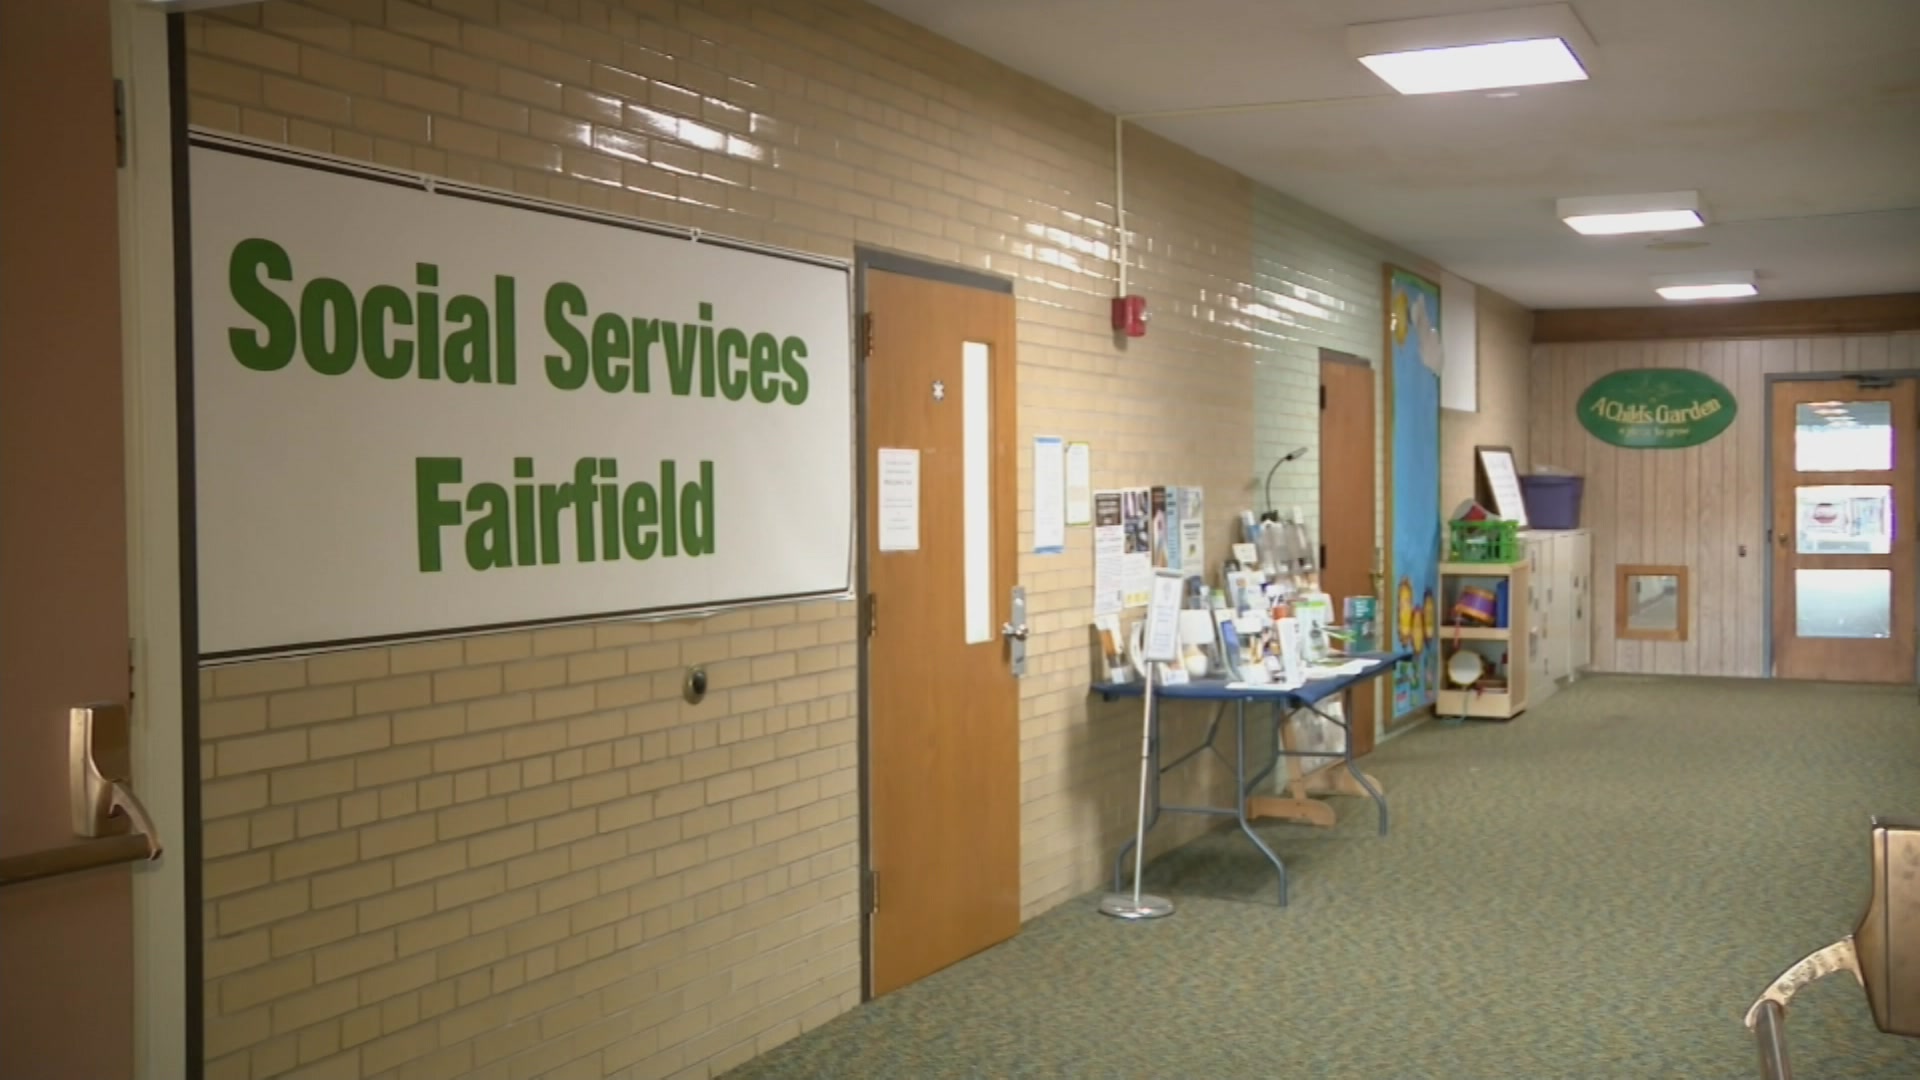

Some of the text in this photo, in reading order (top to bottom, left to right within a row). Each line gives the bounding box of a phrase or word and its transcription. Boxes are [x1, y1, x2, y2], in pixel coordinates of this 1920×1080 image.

[228, 238, 809, 405] Social Services
[1590, 397, 1607, 416] A
[1656, 398, 1722, 425] Garden
[416, 457, 715, 572] Fairfield
